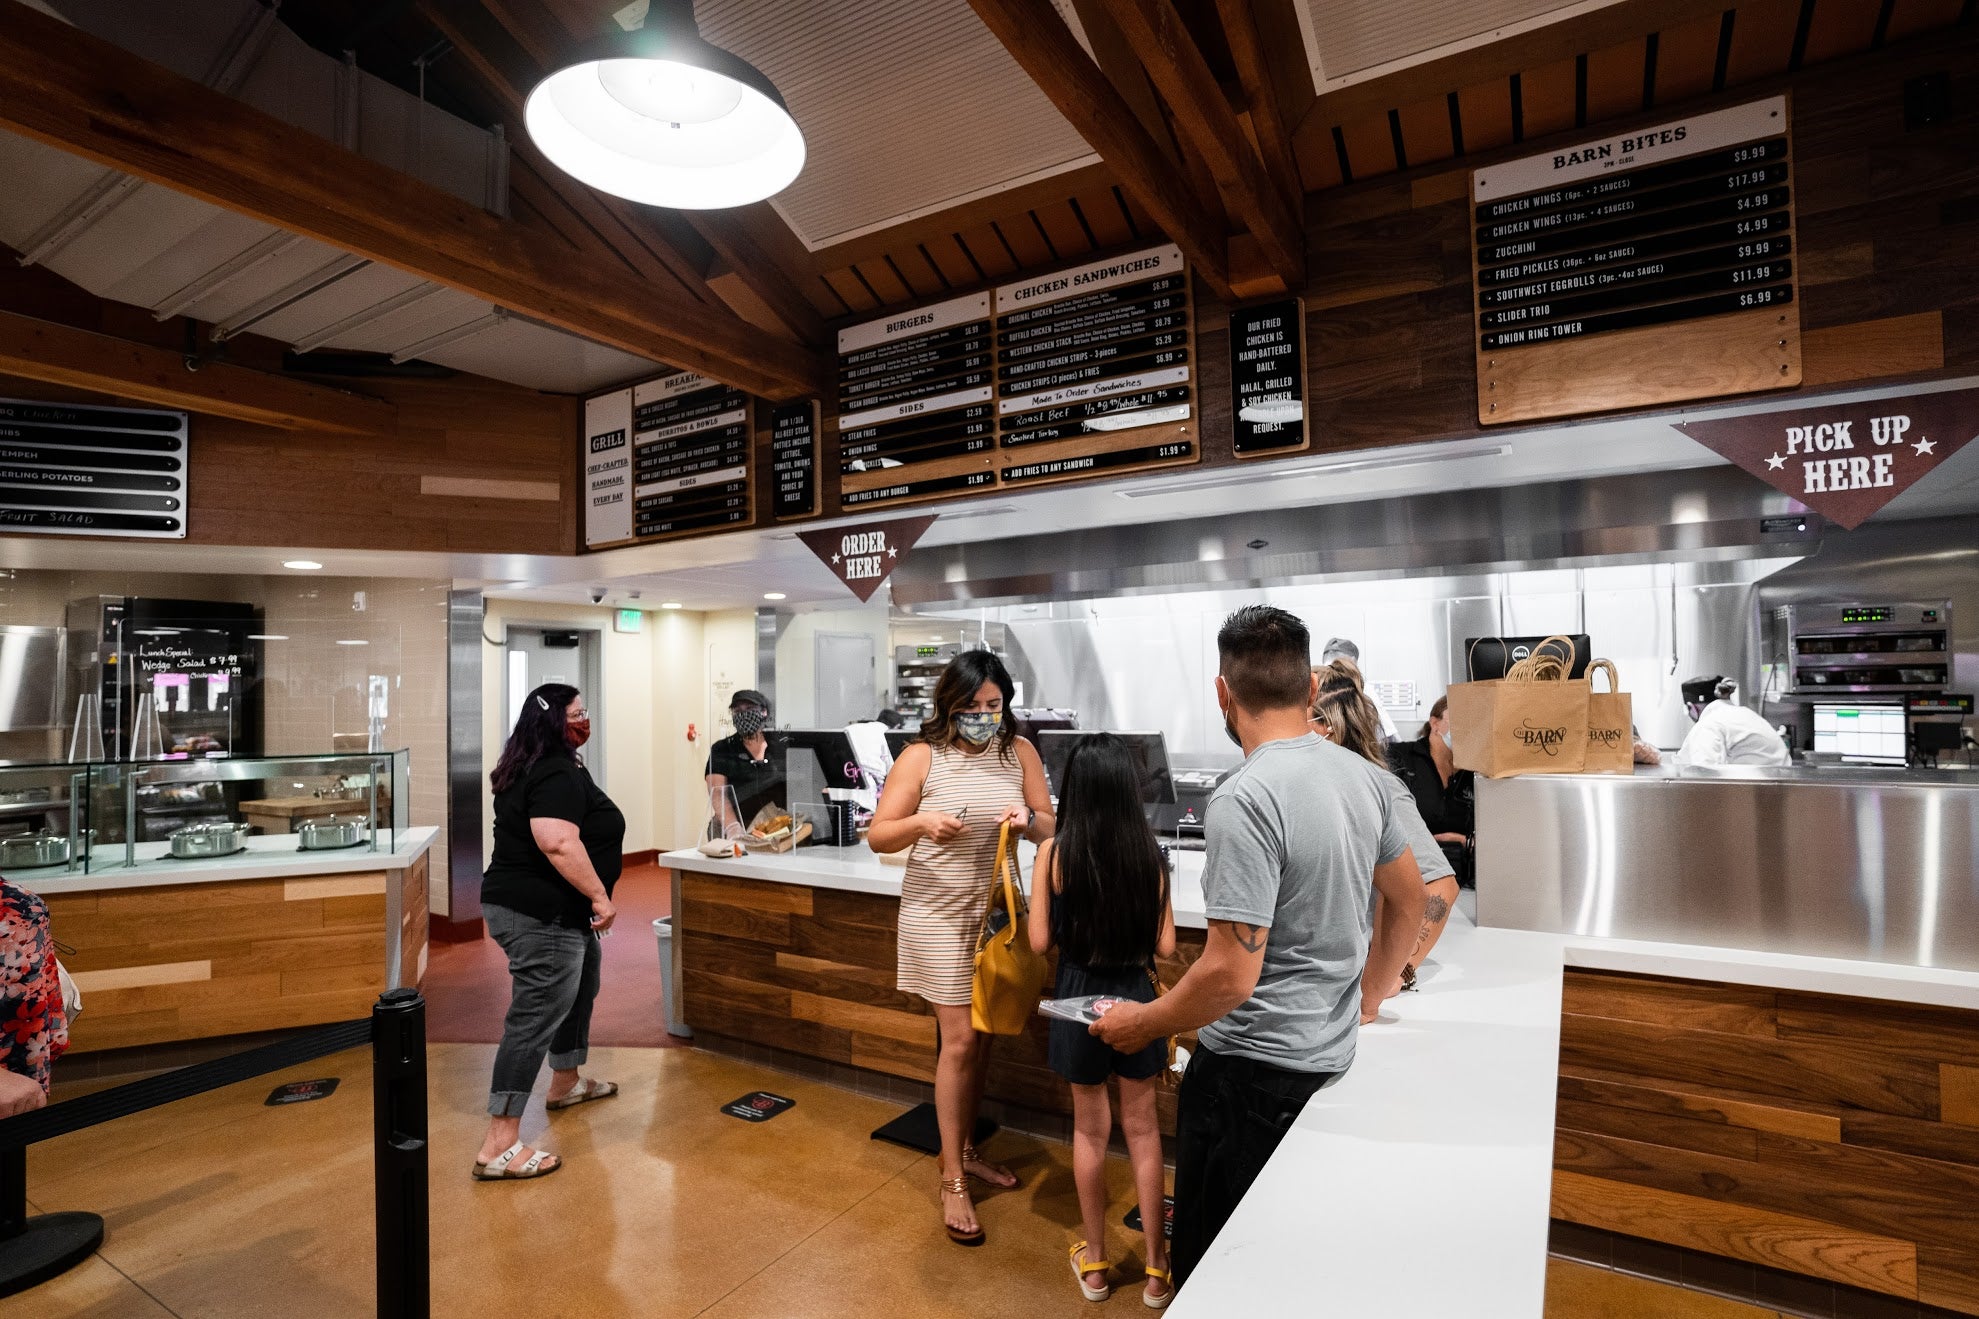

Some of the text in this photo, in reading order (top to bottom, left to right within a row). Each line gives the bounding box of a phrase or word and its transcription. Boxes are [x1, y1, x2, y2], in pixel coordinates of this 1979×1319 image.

[1553, 126, 1687, 169] BARN BITES
[1734, 146, 1765, 162] $9.99
[1728, 171, 1765, 188] $17.99
[1493, 198, 1529, 215] CHICKEN
[1533, 192, 1561, 207] WINGS
[1600, 179, 1630, 192] SAUCES)
[1737, 194, 1768, 210] $4.99
[1493, 217, 1529, 237] CHICKEN
[1533, 214, 1561, 230] WINGS
[1604, 201, 1634, 214] SAUCES)
[1737, 218, 1768, 234] $4.99
[1495, 241, 1536, 258] ZUCCHINI
[1738, 242, 1769, 258] $9.99
[1495, 267, 1519, 280] FRIED
[1523, 259, 1559, 275] PICKLES
[1609, 247, 1634, 259] SAUCE)
[1015, 256, 1160, 300] CHICKEN SANDWICHES
[1497, 264, 1663, 301] SOUTHWEST EGGROLLS SAUCE)
[1733, 266, 1770, 283] $11.99
[1740, 291, 1771, 306] $6.99
[1031, 306, 1053, 320] CHICKEN
[1497, 304, 1550, 323] SLIDER TRIO
[886, 313, 934, 333] BURGERS
[1031, 325, 1052, 338] CHICKEN
[1248, 317, 1281, 332] OUR FRIED
[1155, 335, 1172, 346] $5.29
[1246, 331, 1284, 346] CHICKEN IS
[1498, 322, 1582, 344] ONION RING TOWER
[1010, 337, 1072, 358] WESTERN CHICKEN STACK
[1239, 344, 1292, 362] HAND-BATTERED
[1047, 356, 1068, 368] CHICKEN
[1069, 351, 1088, 363] STRIPS
[1256, 361, 1277, 373] DAILY.
[1010, 379, 1031, 392] CHICKEN
[1033, 375, 1050, 387] STRIPS
[1079, 369, 1083, 378] &
[1084, 366, 1099, 377] FRIES
[1240, 376, 1292, 394] HALAL, GRILLED
[1032, 394, 1052, 406] Made
[1066, 388, 1089, 398] Order
[1093, 379, 1142, 394] Sandwiches
[899, 403, 924, 414] SIDES
[1241, 397, 1246, 408] &
[1248, 395, 1260, 406] SOY
[1015, 412, 1043, 426] Roast
[1048, 407, 1070, 421] Beef
[658, 426, 687, 438] BURRITOS
[696, 418, 718, 429] BOWLS
[848, 428, 876, 440] STEAK FRIES
[1253, 422, 1284, 434] REQUEST.
[1785, 414, 1911, 455] PICK UP
[591, 432, 624, 451] GRILL
[1008, 432, 1034, 444] Smoked
[863, 443, 877, 453] RINGS
[1159, 446, 1178, 457] $1.99
[1011, 458, 1094, 478] ADD FRIES TO ANY SANDWICH
[1802, 453, 1894, 494] HERE
[42, 474, 94, 483] POTATOES
[679, 478, 696, 487] SIDES
[593, 492, 623, 505] EVERY DAY
[849, 493, 858, 502] ADD
[859, 491, 872, 501] FRIES
[873, 489, 879, 499] TO
[880, 488, 889, 498] ANY
[48, 511, 94, 525] SALAD
[841, 531, 886, 556] ORDER
[846, 555, 881, 579] HERE
[140, 644, 164, 657] Lunch
[141, 659, 171, 673] Wedge
[177, 658, 206, 668] Salad
